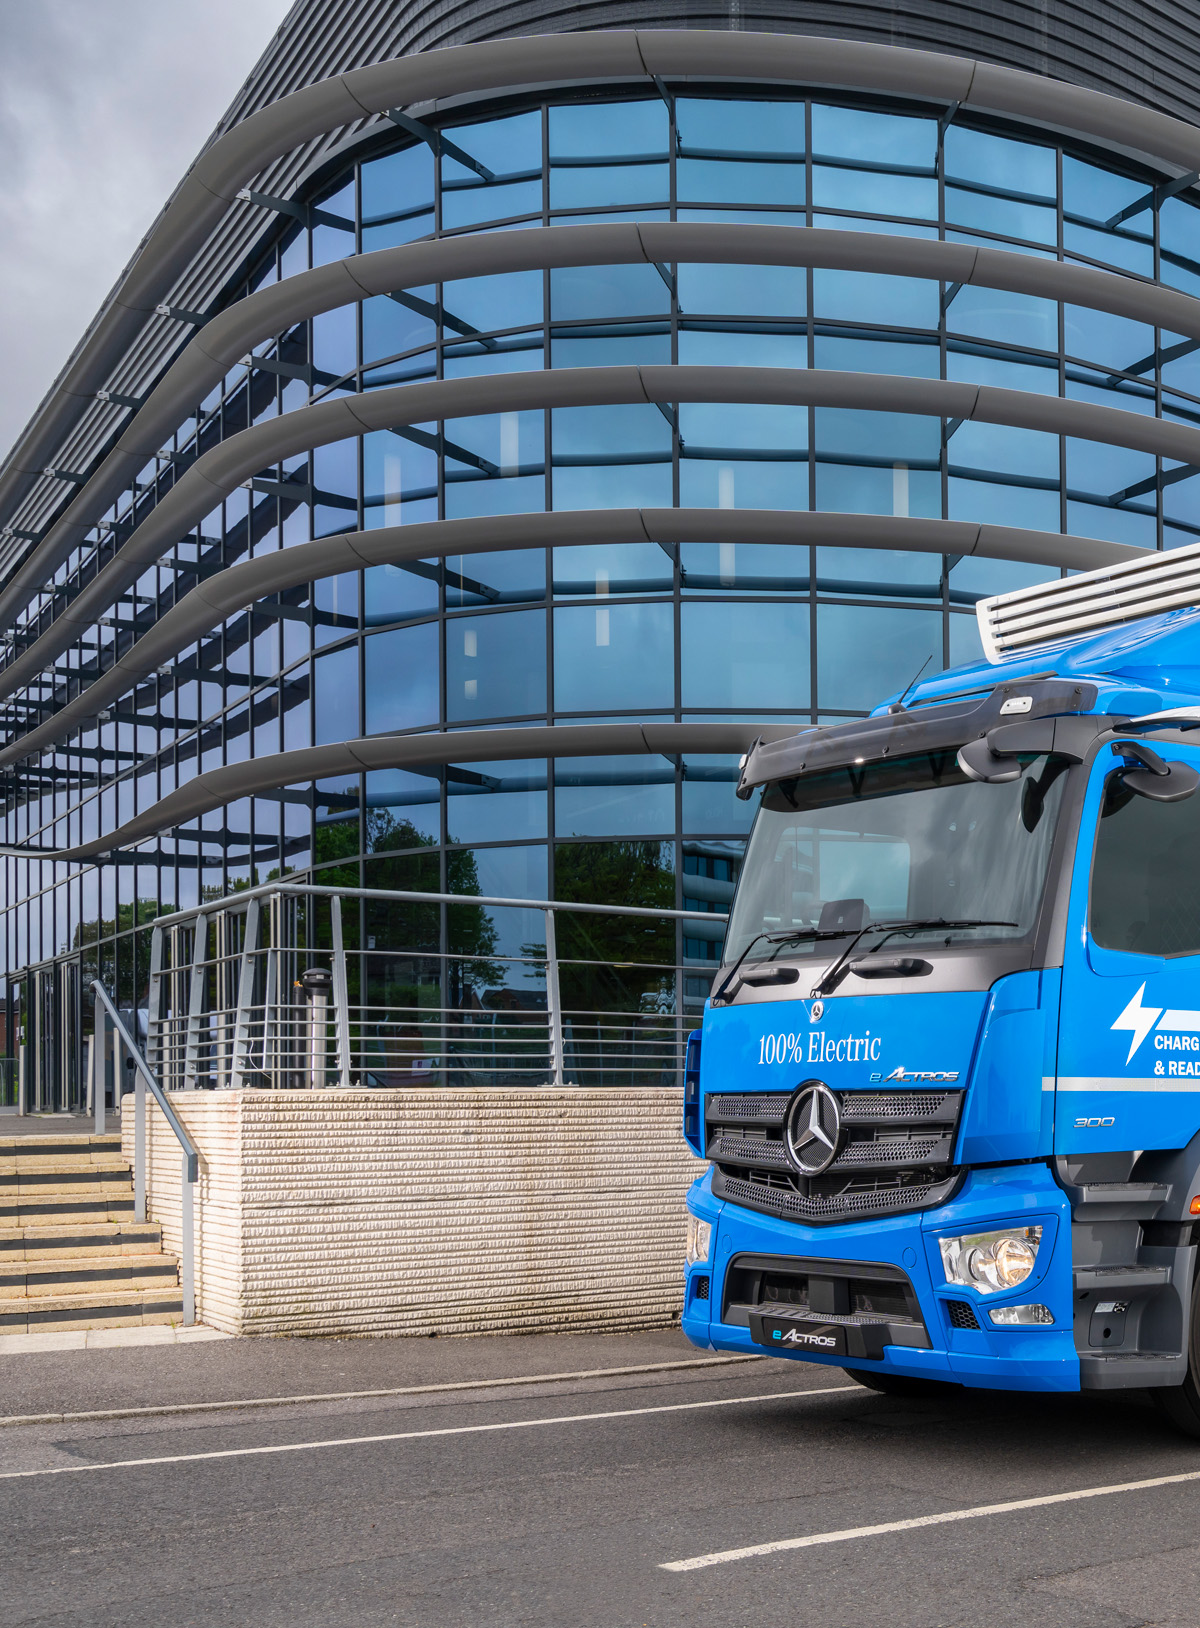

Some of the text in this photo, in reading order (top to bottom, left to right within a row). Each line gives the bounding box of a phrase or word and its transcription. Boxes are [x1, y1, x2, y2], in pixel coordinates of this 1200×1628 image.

[758, 1030, 882, 1065] 100% Electric
[1154, 1061, 1165, 1076] &
[1073, 1116, 1116, 1129] 300
